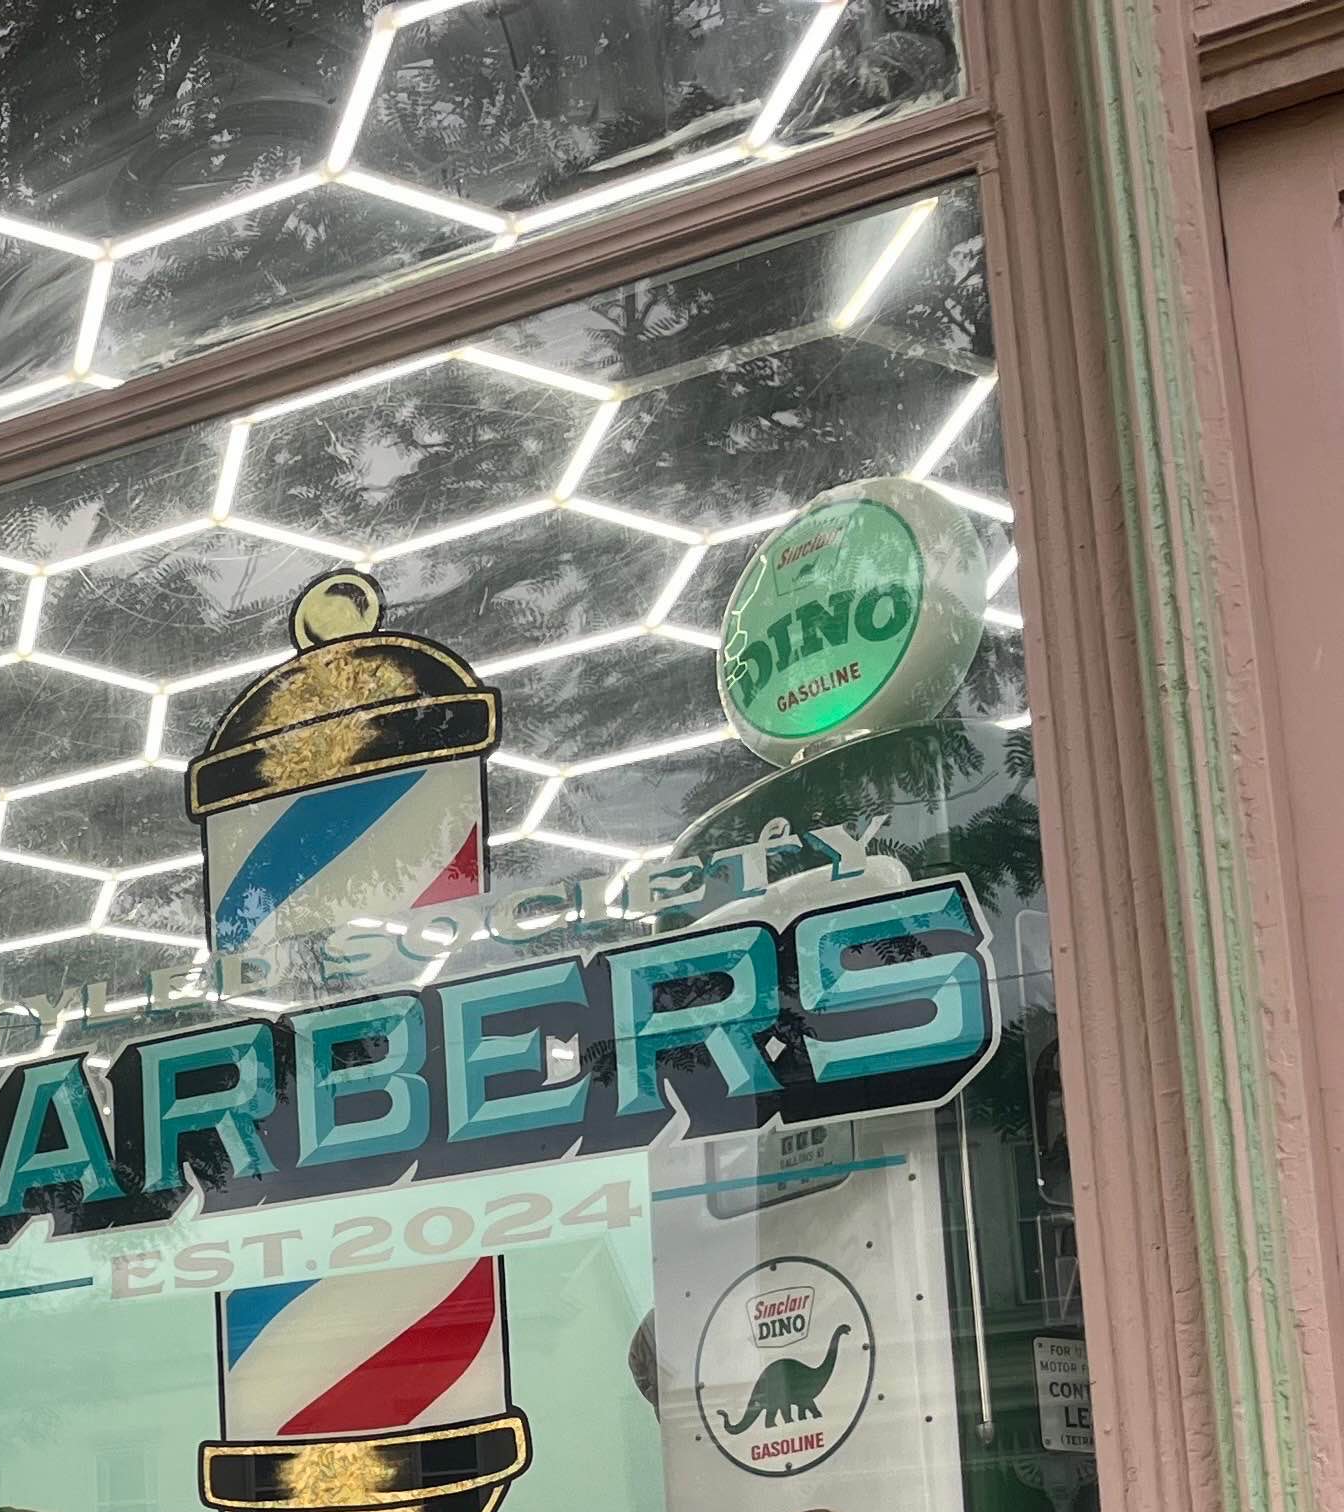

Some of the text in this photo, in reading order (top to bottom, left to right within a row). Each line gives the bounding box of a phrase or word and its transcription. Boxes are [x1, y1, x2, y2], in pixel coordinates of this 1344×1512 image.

[736, 583, 912, 708] DINO
[777, 662, 861, 713] GASOLINE
[320, 815, 889, 978] SOCIETY
[754, 1294, 811, 1321] Sinclair
[758, 1313, 806, 1342] DINO
[1050, 1345, 1070, 1356] FOR
[1040, 1361, 1077, 1373] MOTOR
[1065, 1407, 1093, 1429] LE
[751, 1432, 824, 1461] GASOLINE
